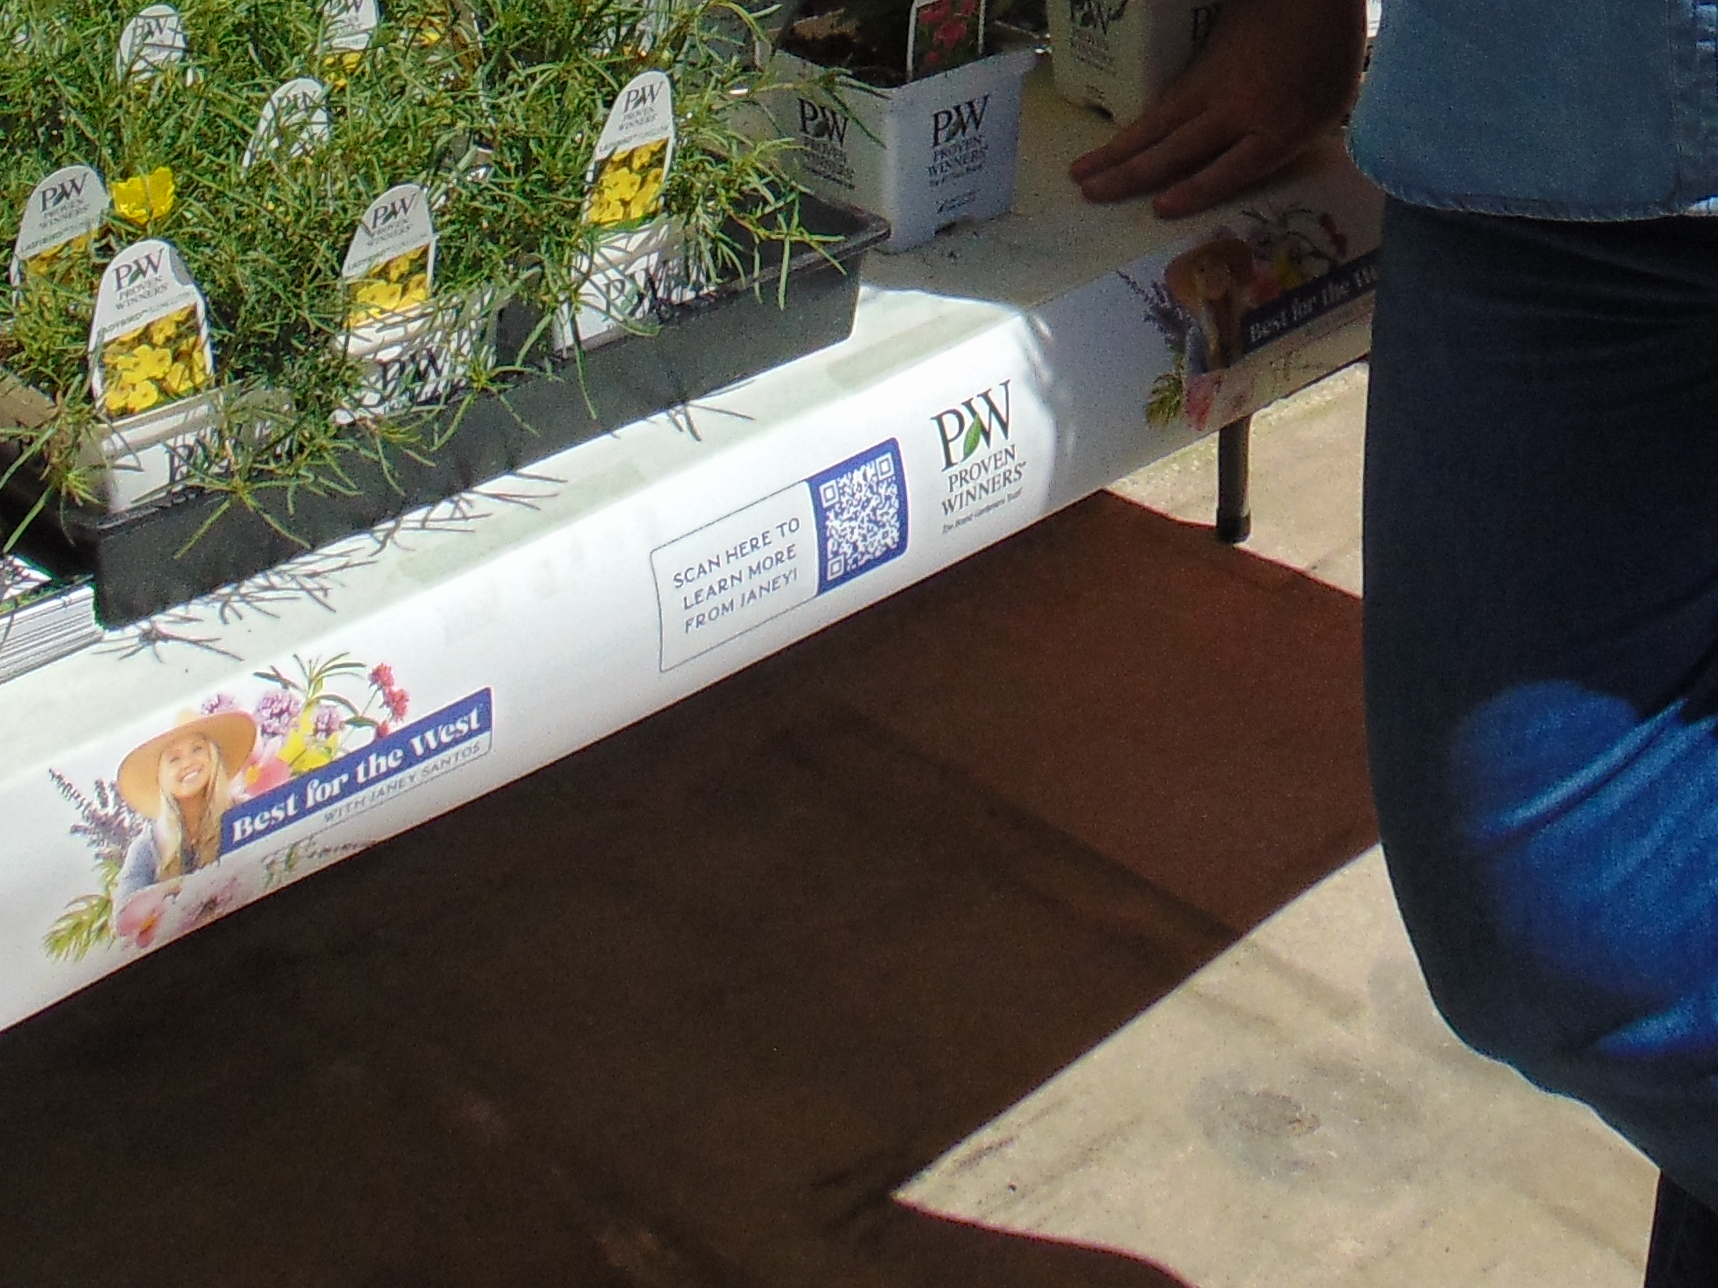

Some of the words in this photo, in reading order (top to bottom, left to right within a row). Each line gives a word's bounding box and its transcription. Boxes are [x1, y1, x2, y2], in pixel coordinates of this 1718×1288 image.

[623, 80, 664, 114] PW
[931, 94, 991, 146] PW
[41, 172, 88, 213] PW
[371, 191, 417, 230] PW
[112, 247, 165, 293] PW
[930, 379, 1012, 473] PW
[941, 467, 1025, 516] WINNERS
[948, 444, 1016, 493] PROVEN
[673, 554, 721, 589] SCAN
[726, 530, 773, 564] HERE
[776, 517, 800, 538] TO
[683, 570, 743, 611] LEARN
[748, 544, 797, 580] MORE
[685, 598, 734, 634] FROM
[232, 790, 299, 843] Best
[305, 771, 350, 809] for
[356, 747, 405, 785] the
[410, 706, 482, 757] West
[323, 796, 366, 824] WITH
[370, 775, 420, 803] JANEY
[422, 743, 481, 776] SANTOS
